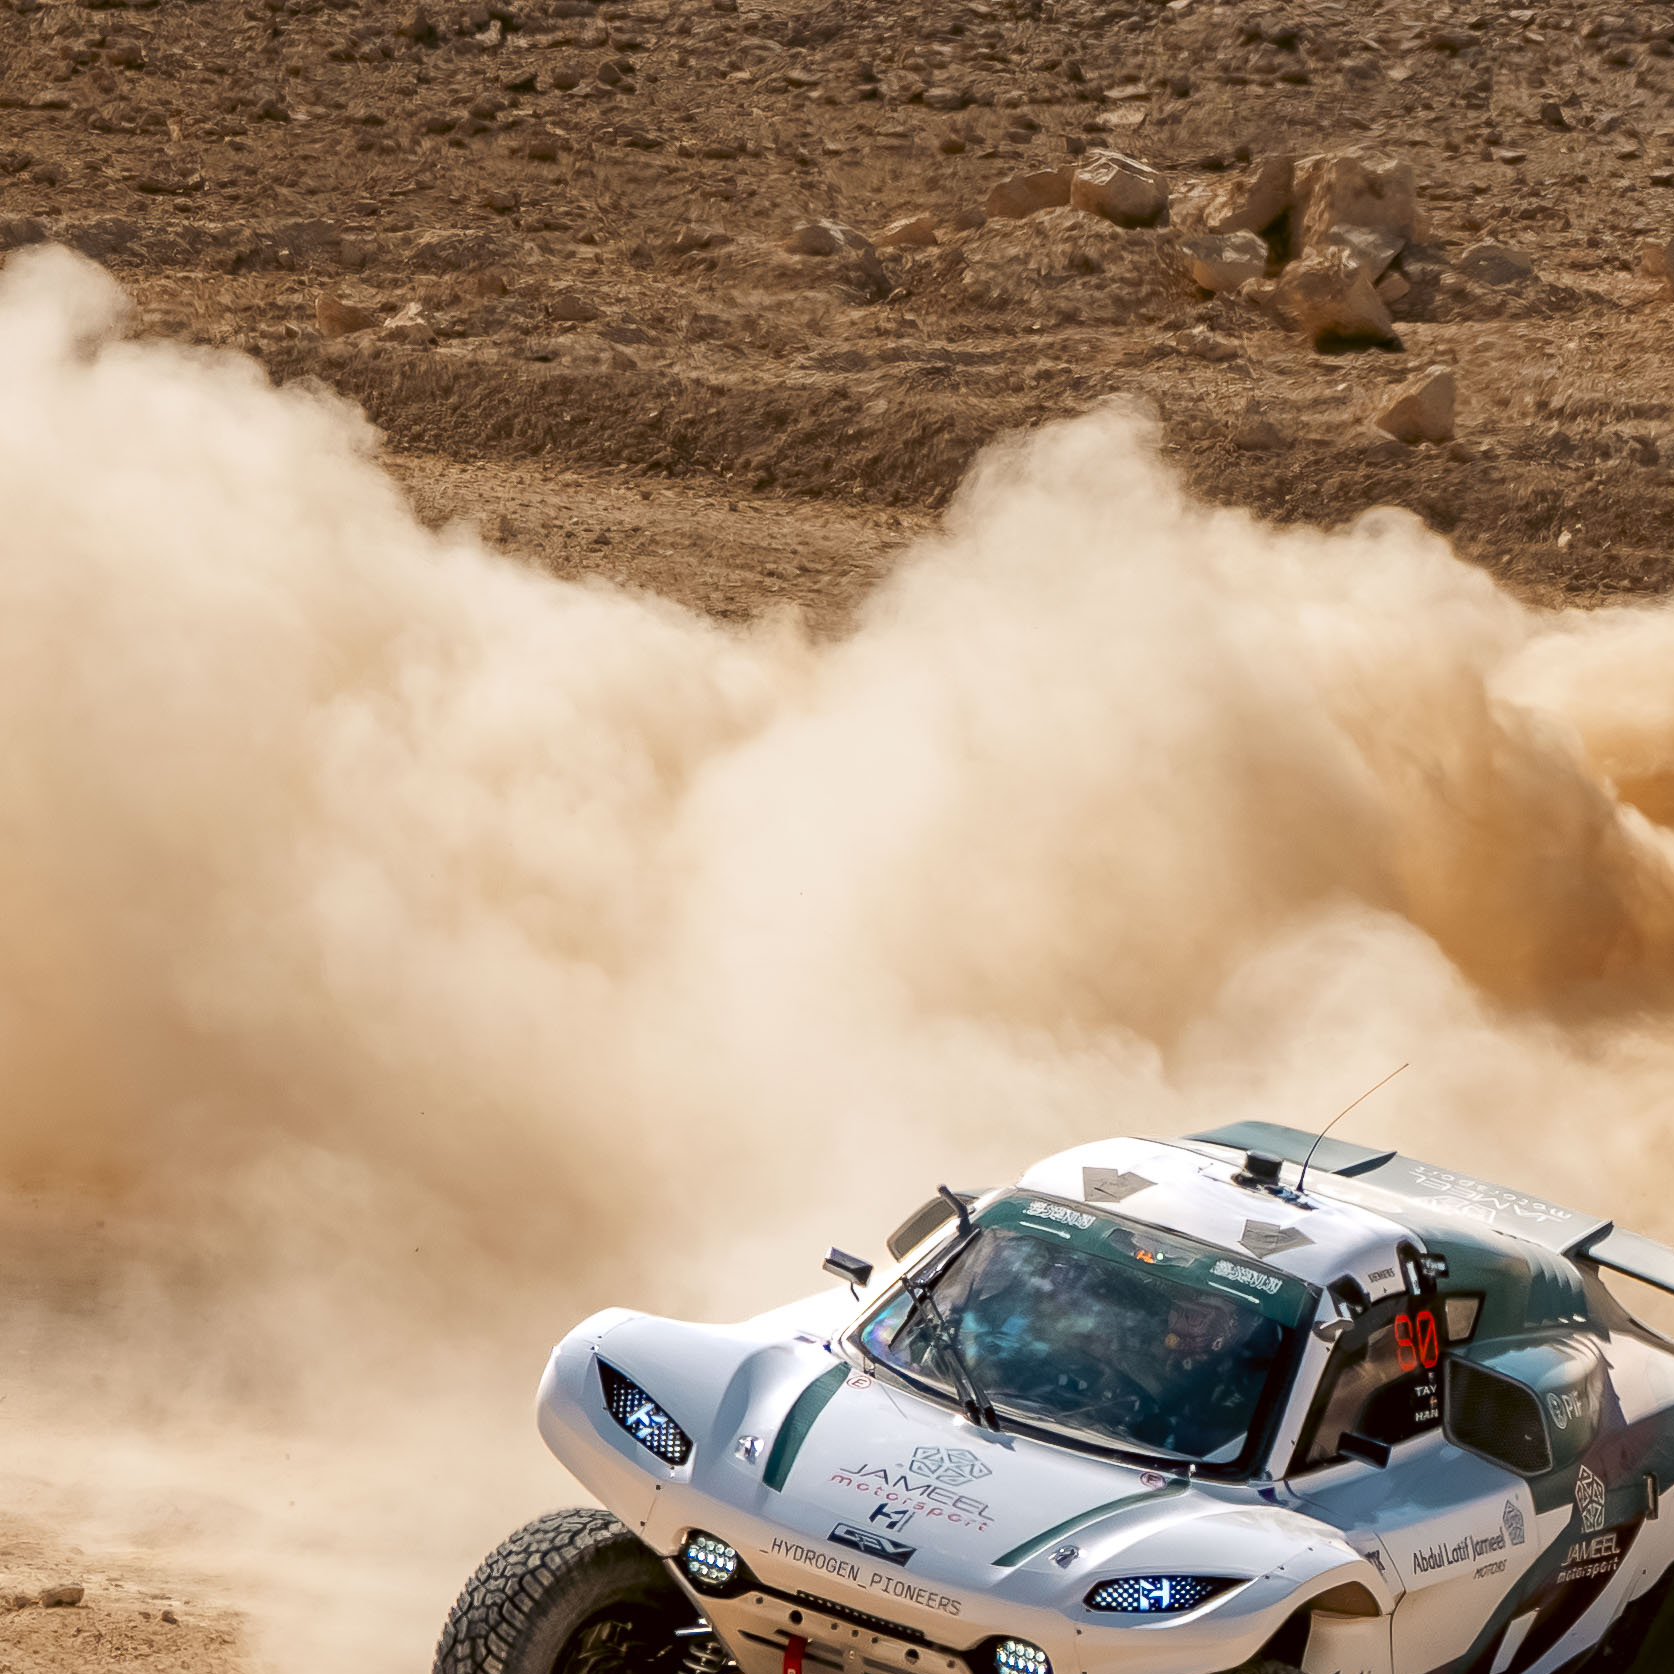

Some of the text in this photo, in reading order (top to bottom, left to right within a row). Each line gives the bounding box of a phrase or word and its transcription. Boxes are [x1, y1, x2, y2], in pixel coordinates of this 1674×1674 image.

[830, 1474, 992, 1532] motorsport
[839, 1463, 995, 1522] JAMEEL
[1412, 1543, 1445, 1575] Abdul
[1444, 1535, 1470, 1565] Latif
[1471, 1526, 1506, 1562] Jameel
[1556, 1556, 1619, 1584] motorsport
[1560, 1533, 1621, 1567] JAMEEL
